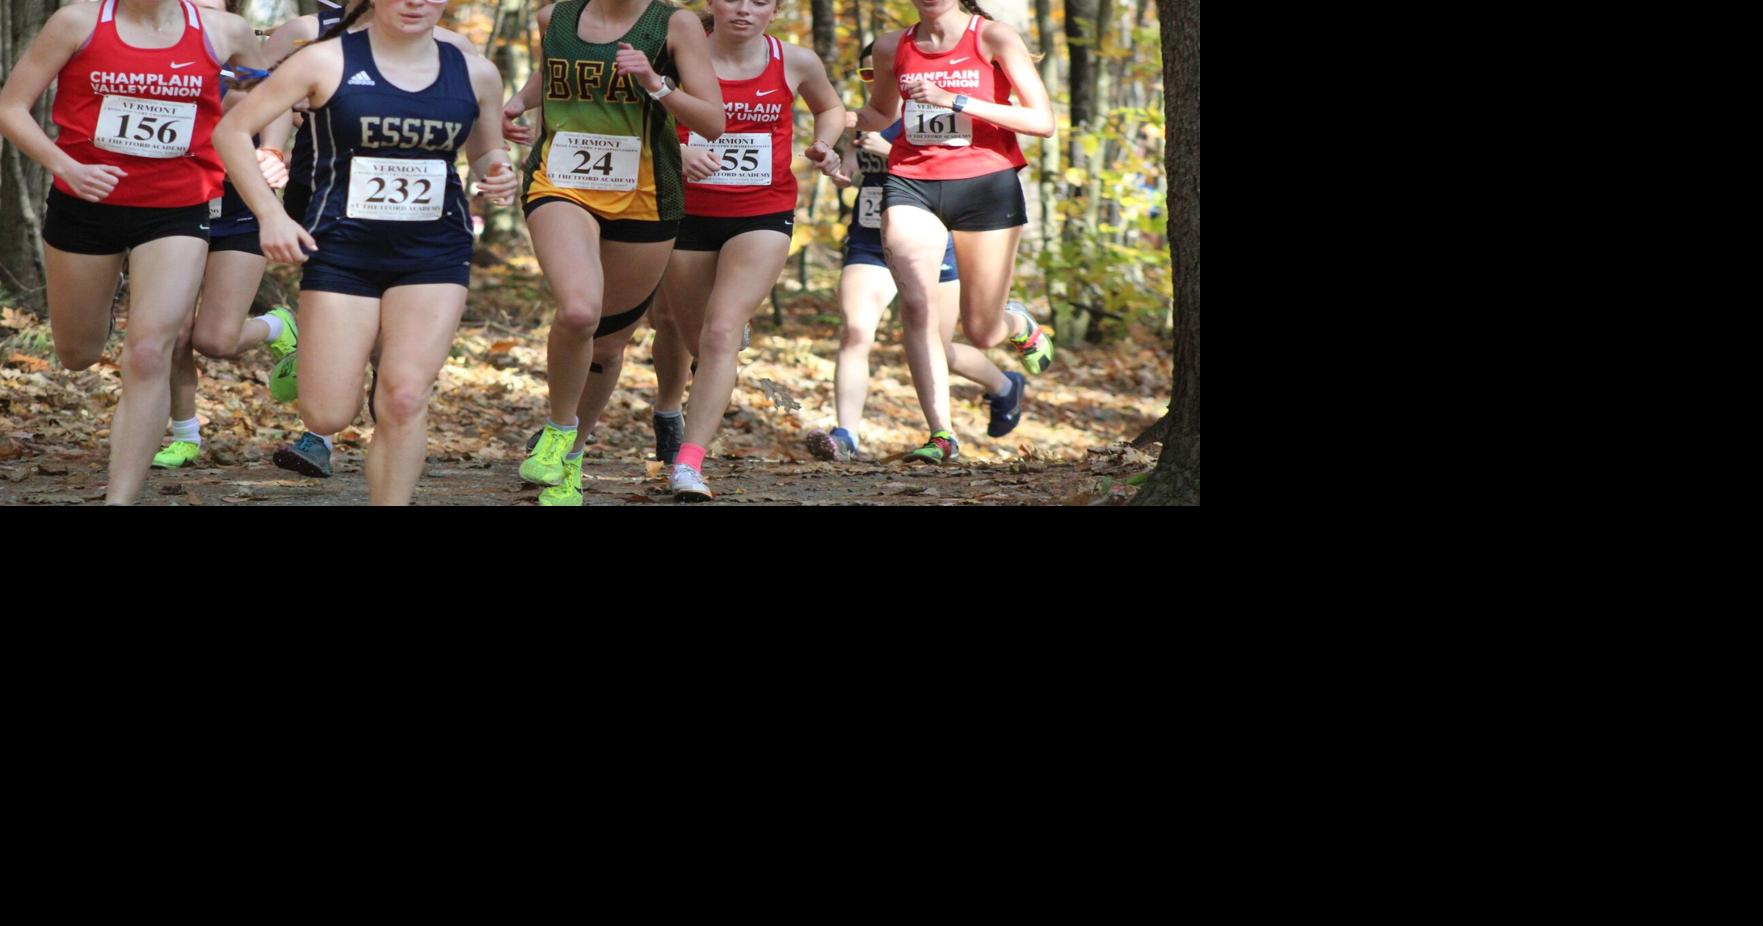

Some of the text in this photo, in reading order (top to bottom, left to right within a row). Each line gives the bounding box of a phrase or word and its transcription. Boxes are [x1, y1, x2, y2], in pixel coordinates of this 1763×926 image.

[90, 71, 202, 88] CHAMPLAIN
[547, 58, 640, 104] BFA
[900, 69, 979, 83] CHAMPLAIN
[938, 79, 979, 88] UNION
[91, 82, 201, 97] VALLEY UNION
[123, 101, 176, 116] VERMONT
[722, 102, 782, 114] MPLAIN
[737, 112, 780, 122] UNION
[916, 113, 959, 134] 161
[113, 114, 181, 145] 156
[360, 116, 462, 151] ESSEX
[568, 138, 622, 148] VERMONT
[571, 149, 613, 176] 24
[709, 148, 759, 171] 55
[373, 164, 427, 173] VERMONT
[365, 177, 432, 204] 232
